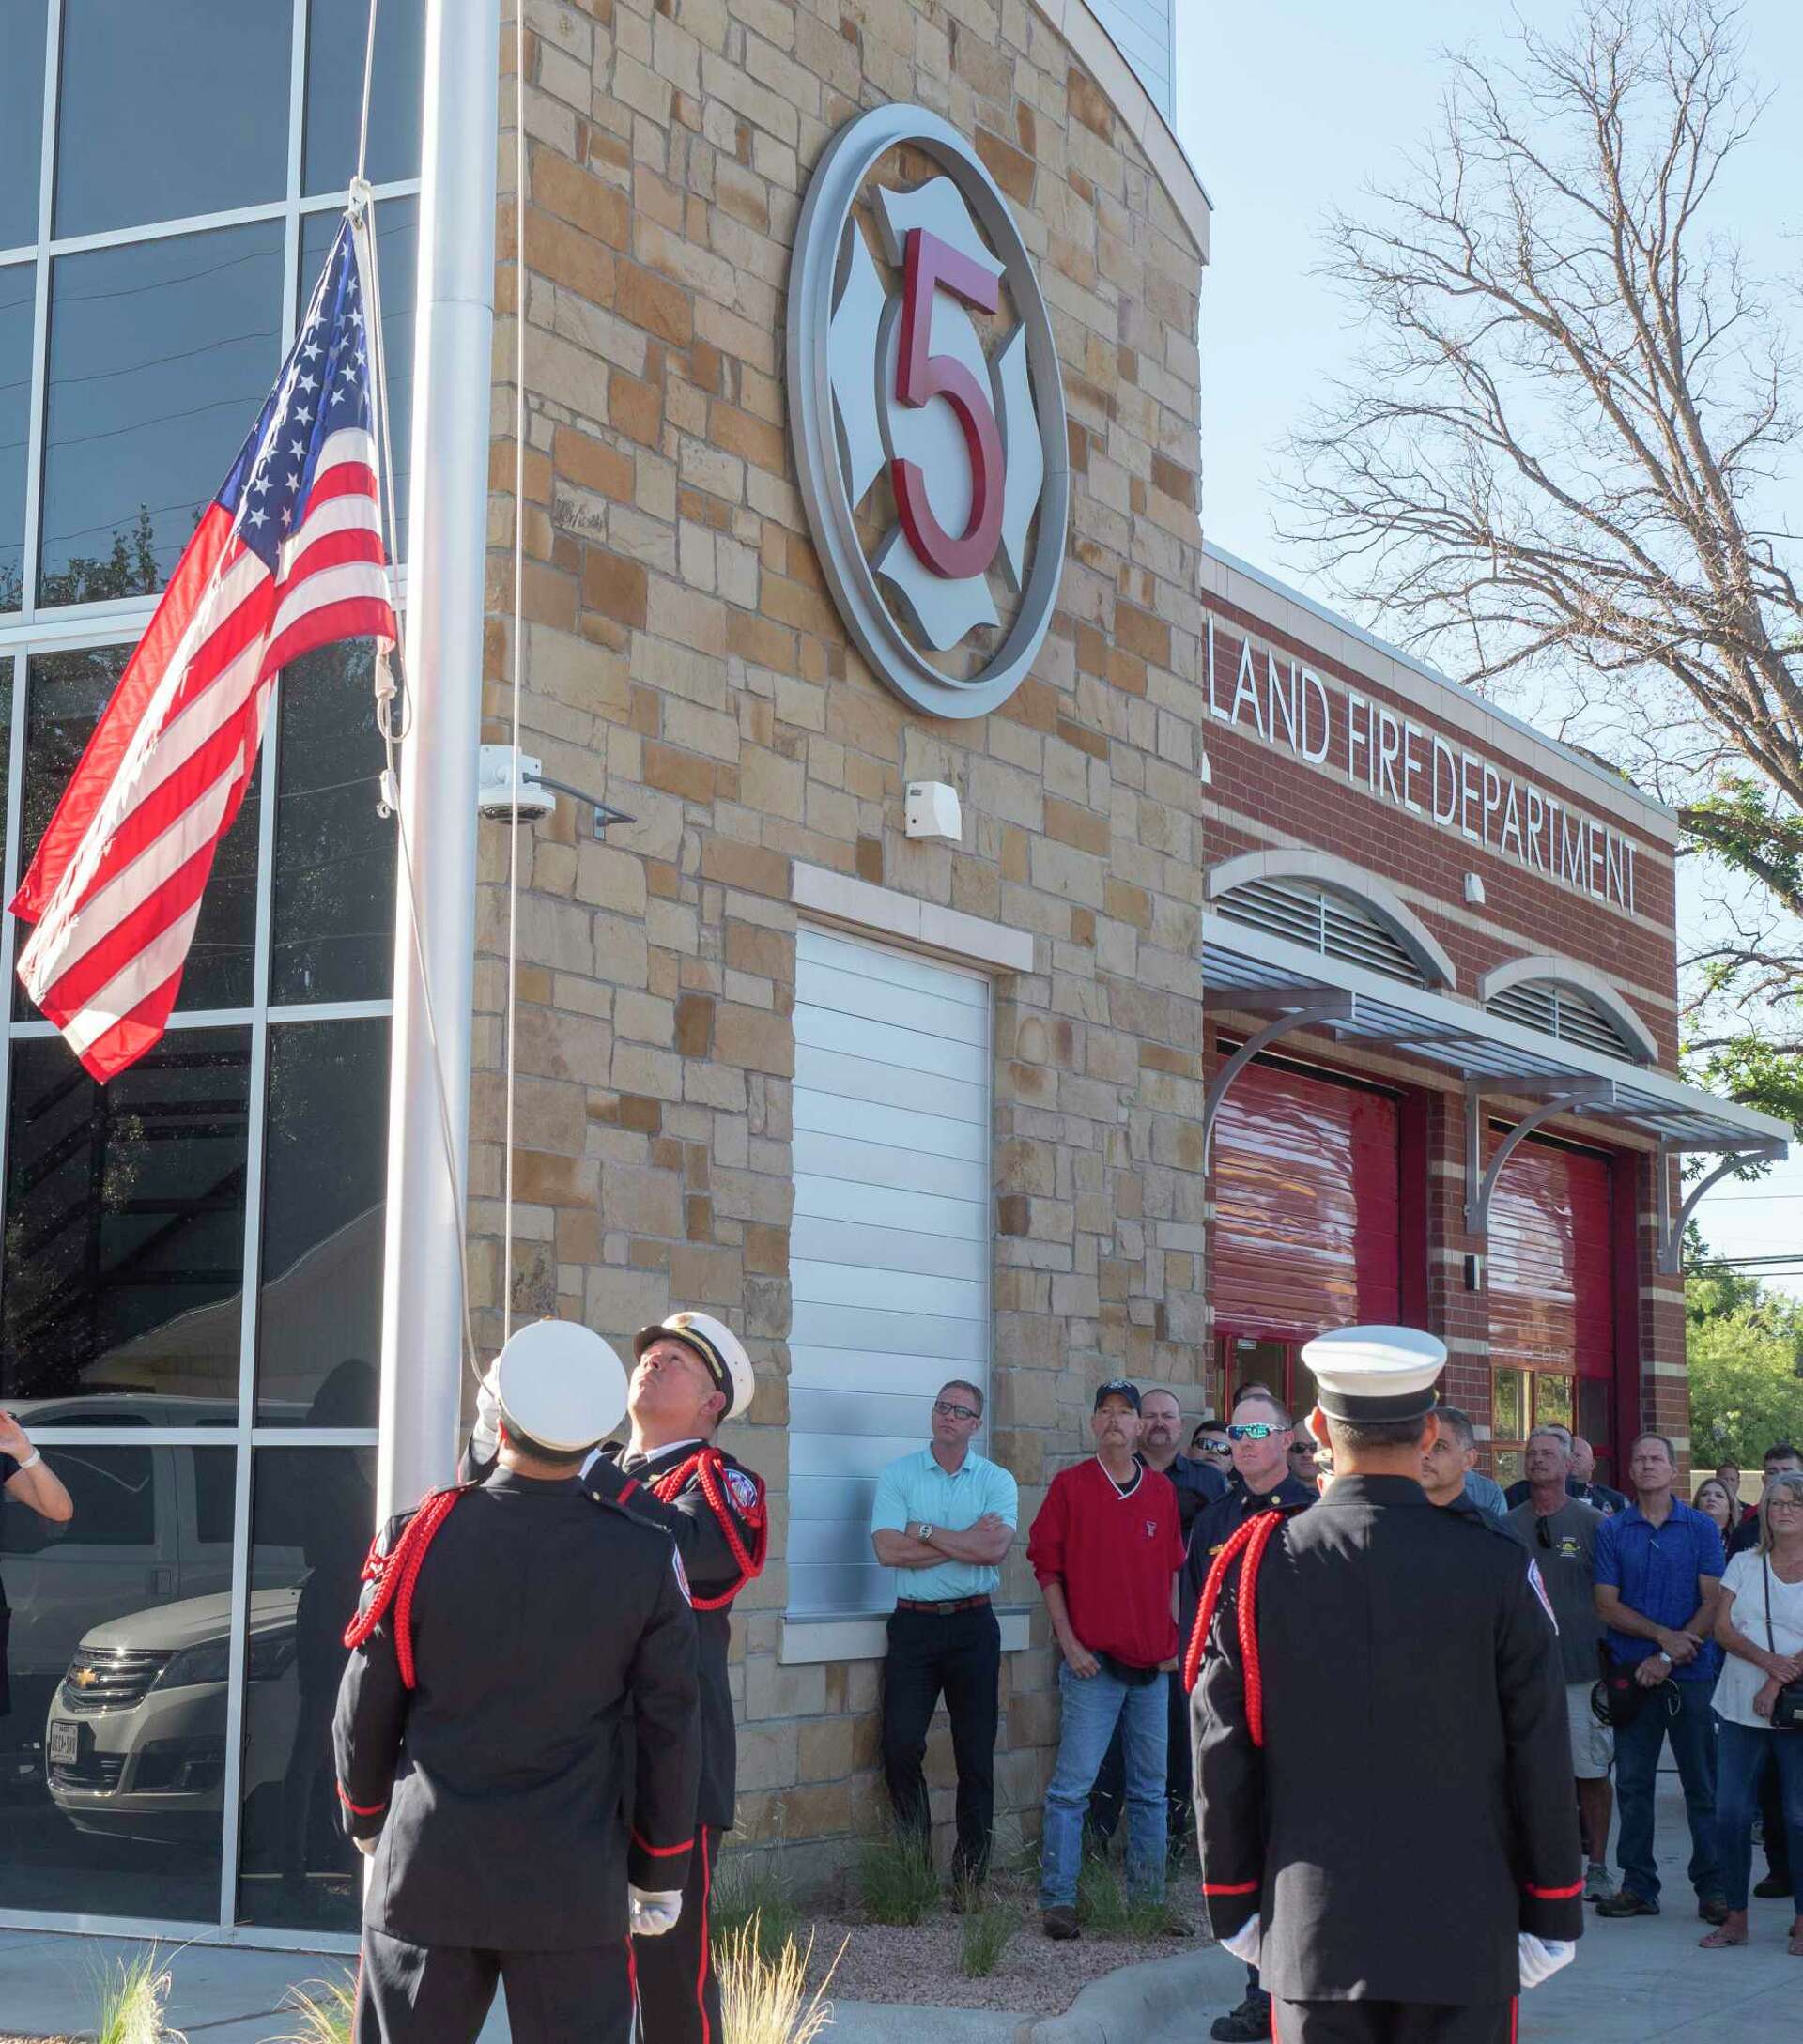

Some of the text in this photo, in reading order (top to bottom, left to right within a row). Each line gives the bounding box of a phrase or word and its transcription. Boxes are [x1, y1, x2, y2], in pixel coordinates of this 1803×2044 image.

[892, 227, 1005, 579] 5
[1348, 692, 1422, 815] FIRE
[1432, 735, 1637, 916] DEPARTMENT
